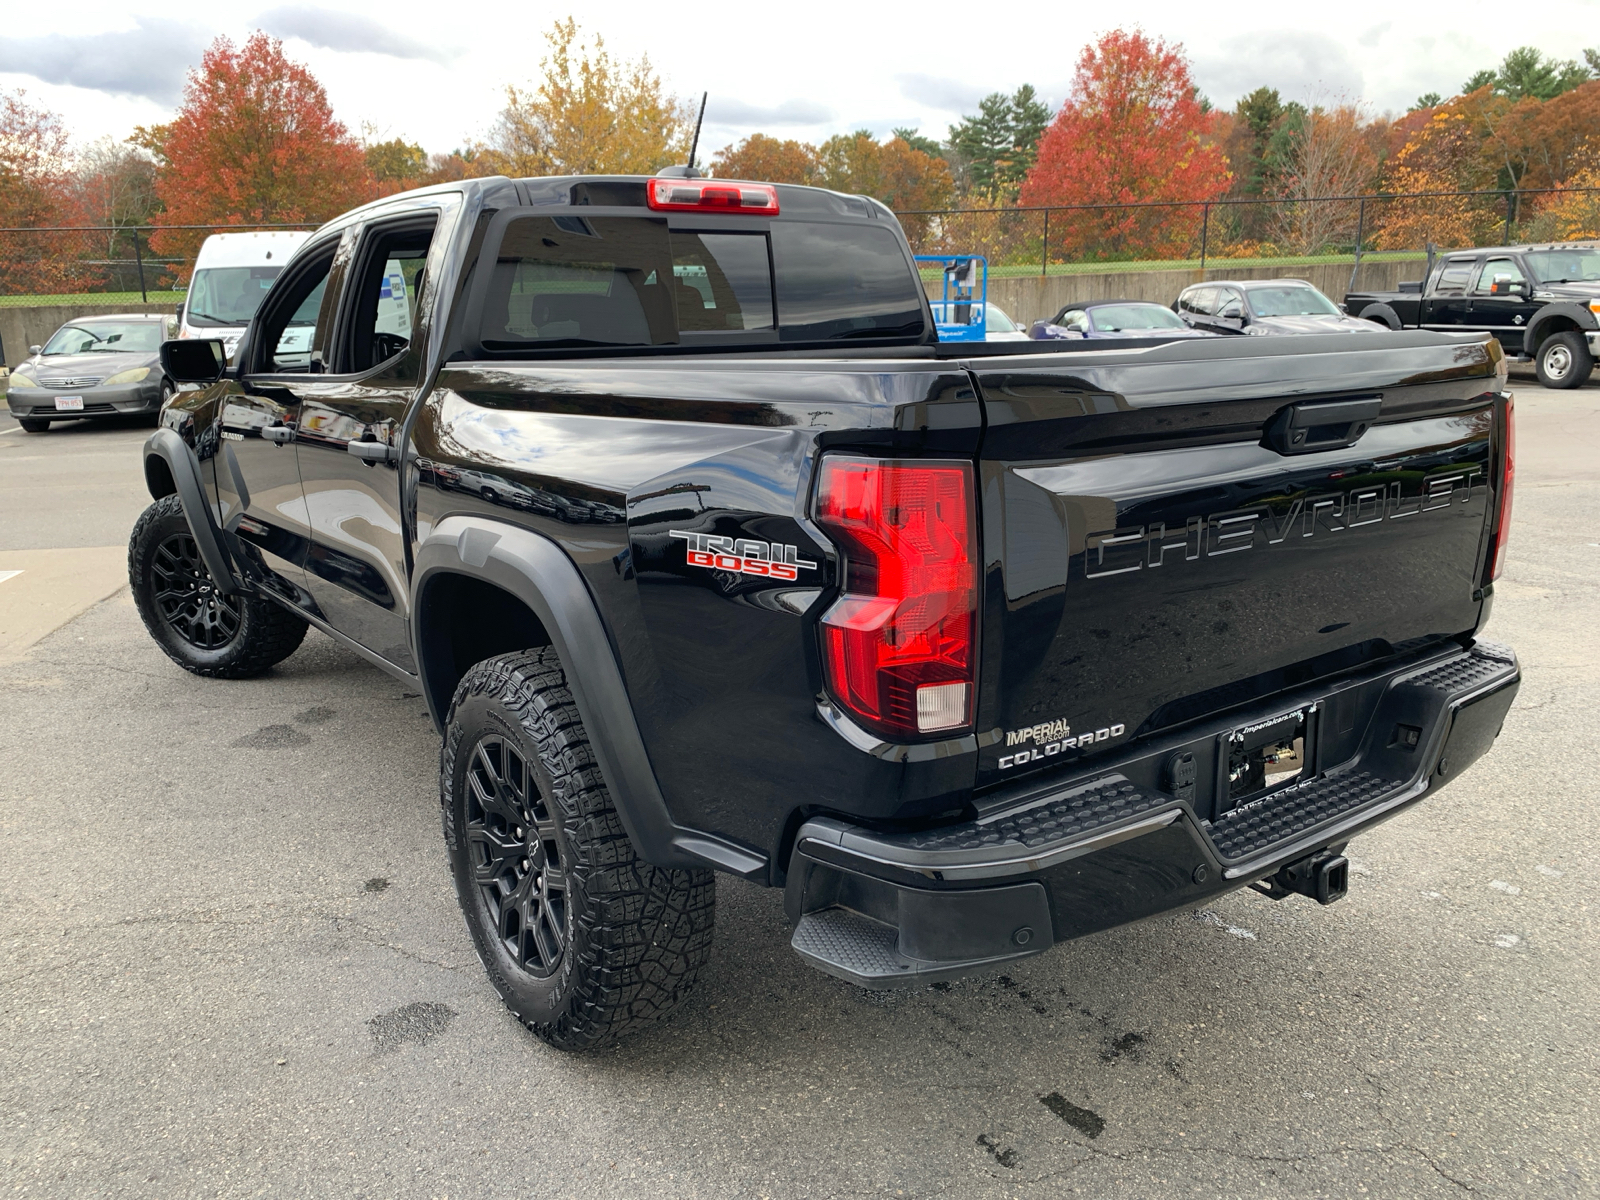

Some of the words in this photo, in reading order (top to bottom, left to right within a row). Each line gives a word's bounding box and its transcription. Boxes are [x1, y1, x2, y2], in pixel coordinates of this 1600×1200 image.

[1085, 465, 1482, 579] CHEVROLET
[669, 529, 817, 570] TRAIL
[687, 550, 798, 581] BOSS
[998, 723, 1126, 770] COLORADO
[1006, 717, 1071, 747] IMPERIAL
[1035, 729, 1070, 746] cars.com
